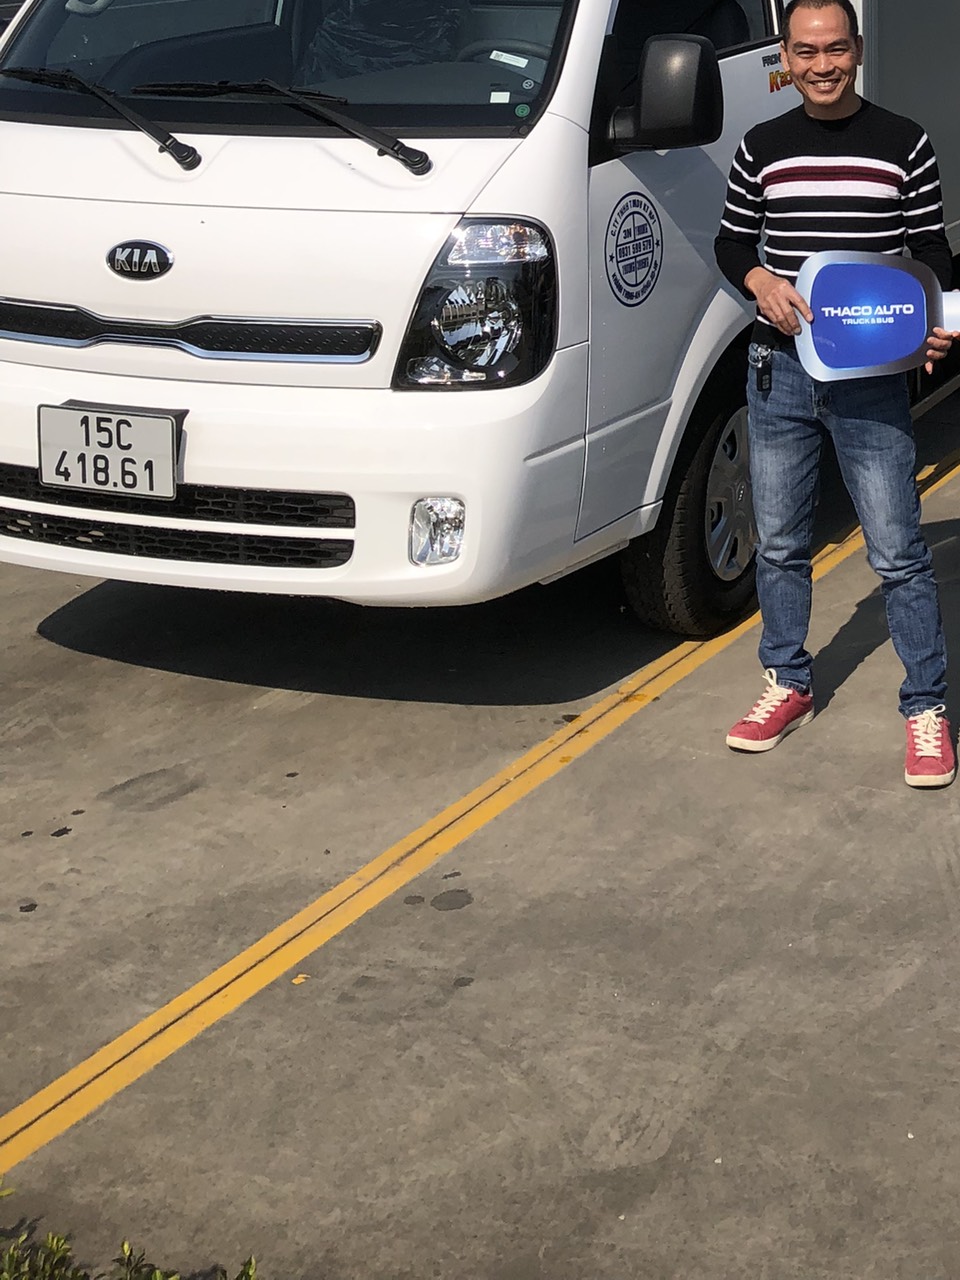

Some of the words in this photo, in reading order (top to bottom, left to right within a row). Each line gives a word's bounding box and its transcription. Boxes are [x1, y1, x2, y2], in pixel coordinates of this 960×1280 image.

[114, 247, 160, 272] KIA
[821, 305, 872, 317] THACO
[874, 304, 914, 315] AUTO
[80, 415, 133, 451] 15C
[54, 450, 155, 492] 418.61
